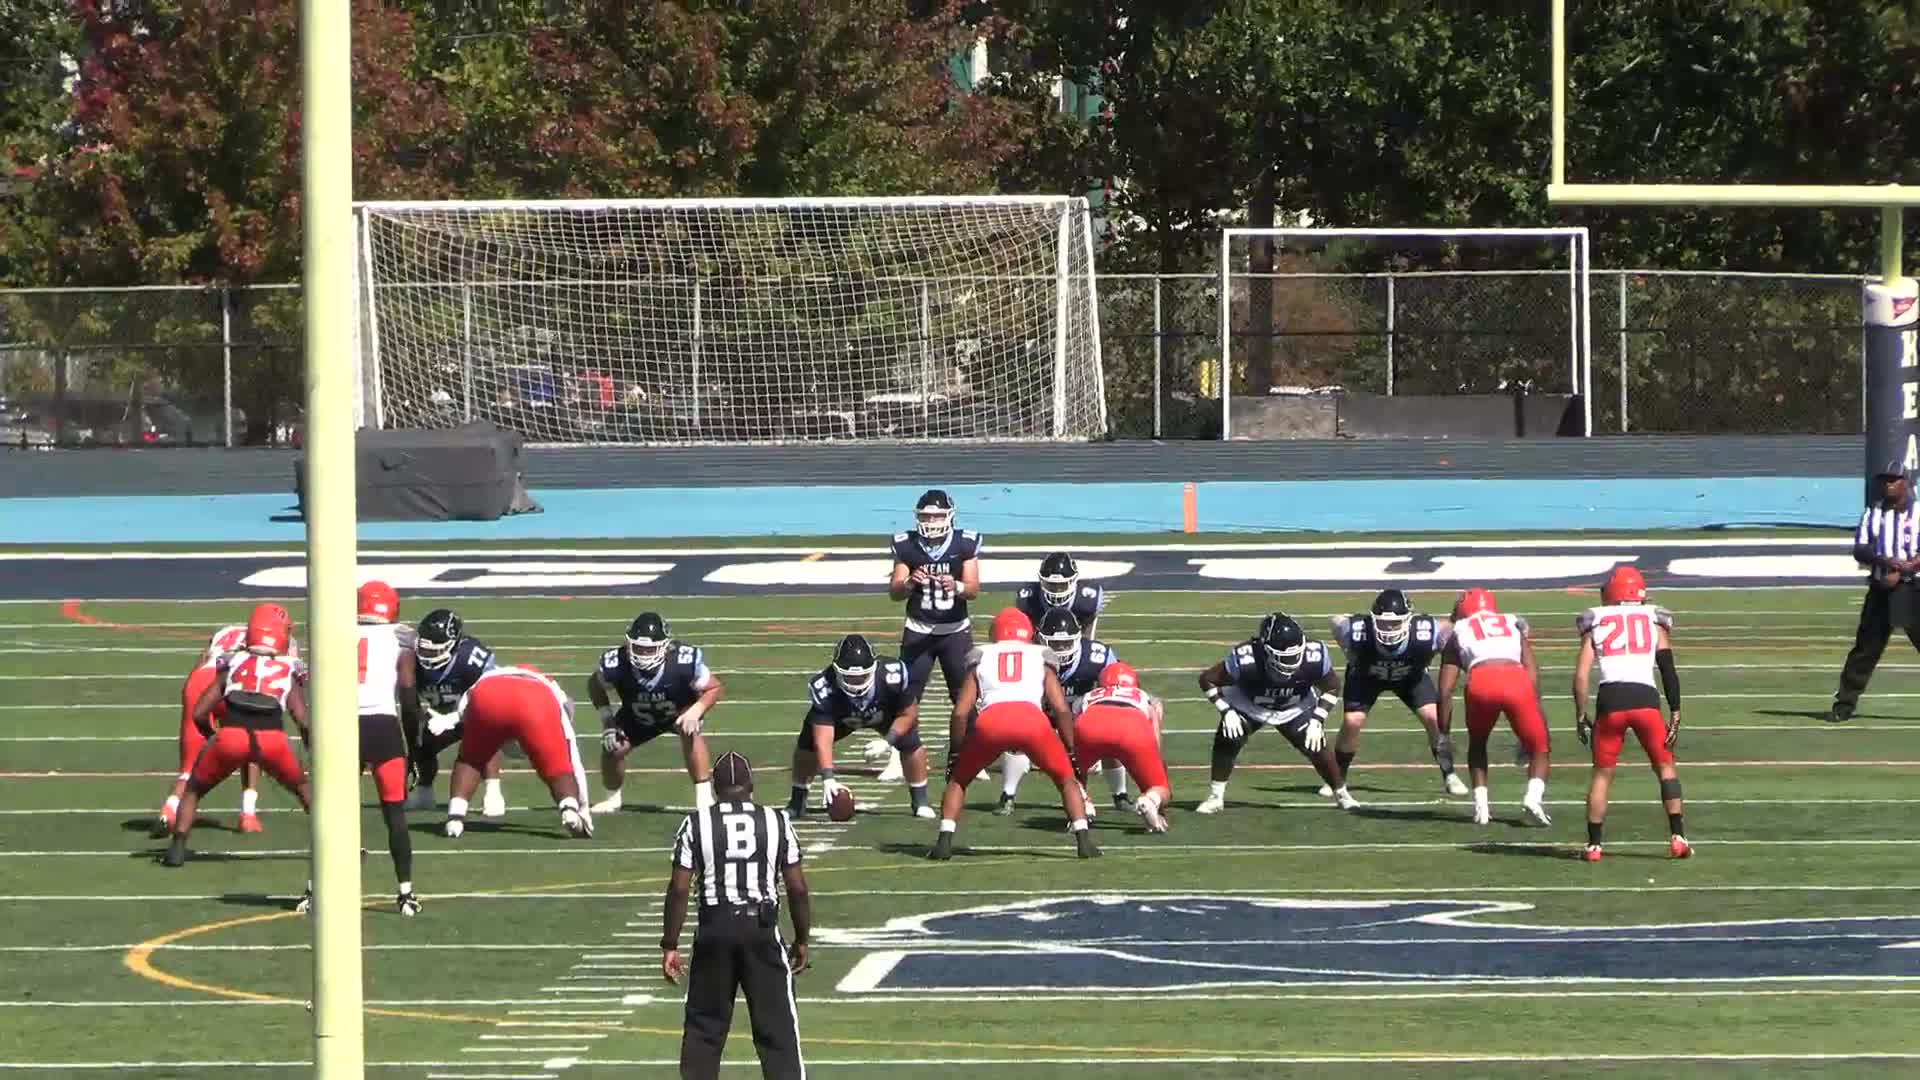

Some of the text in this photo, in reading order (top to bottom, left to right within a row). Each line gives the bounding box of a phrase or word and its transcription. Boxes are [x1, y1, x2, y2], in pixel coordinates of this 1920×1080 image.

[1081, 587, 1097, 599] 3
[1468, 614, 1513, 641] 13
[1600, 613, 1651, 657] 20
[467, 646, 488, 669] 77
[603, 649, 619, 669] 53
[677, 645, 695, 665] 53
[1090, 642, 1107, 665] 63
[1237, 644, 1256, 665] 54
[231, 655, 291, 698] 42
[997, 651, 1023, 683] 0
[722, 814, 758, 860] B
